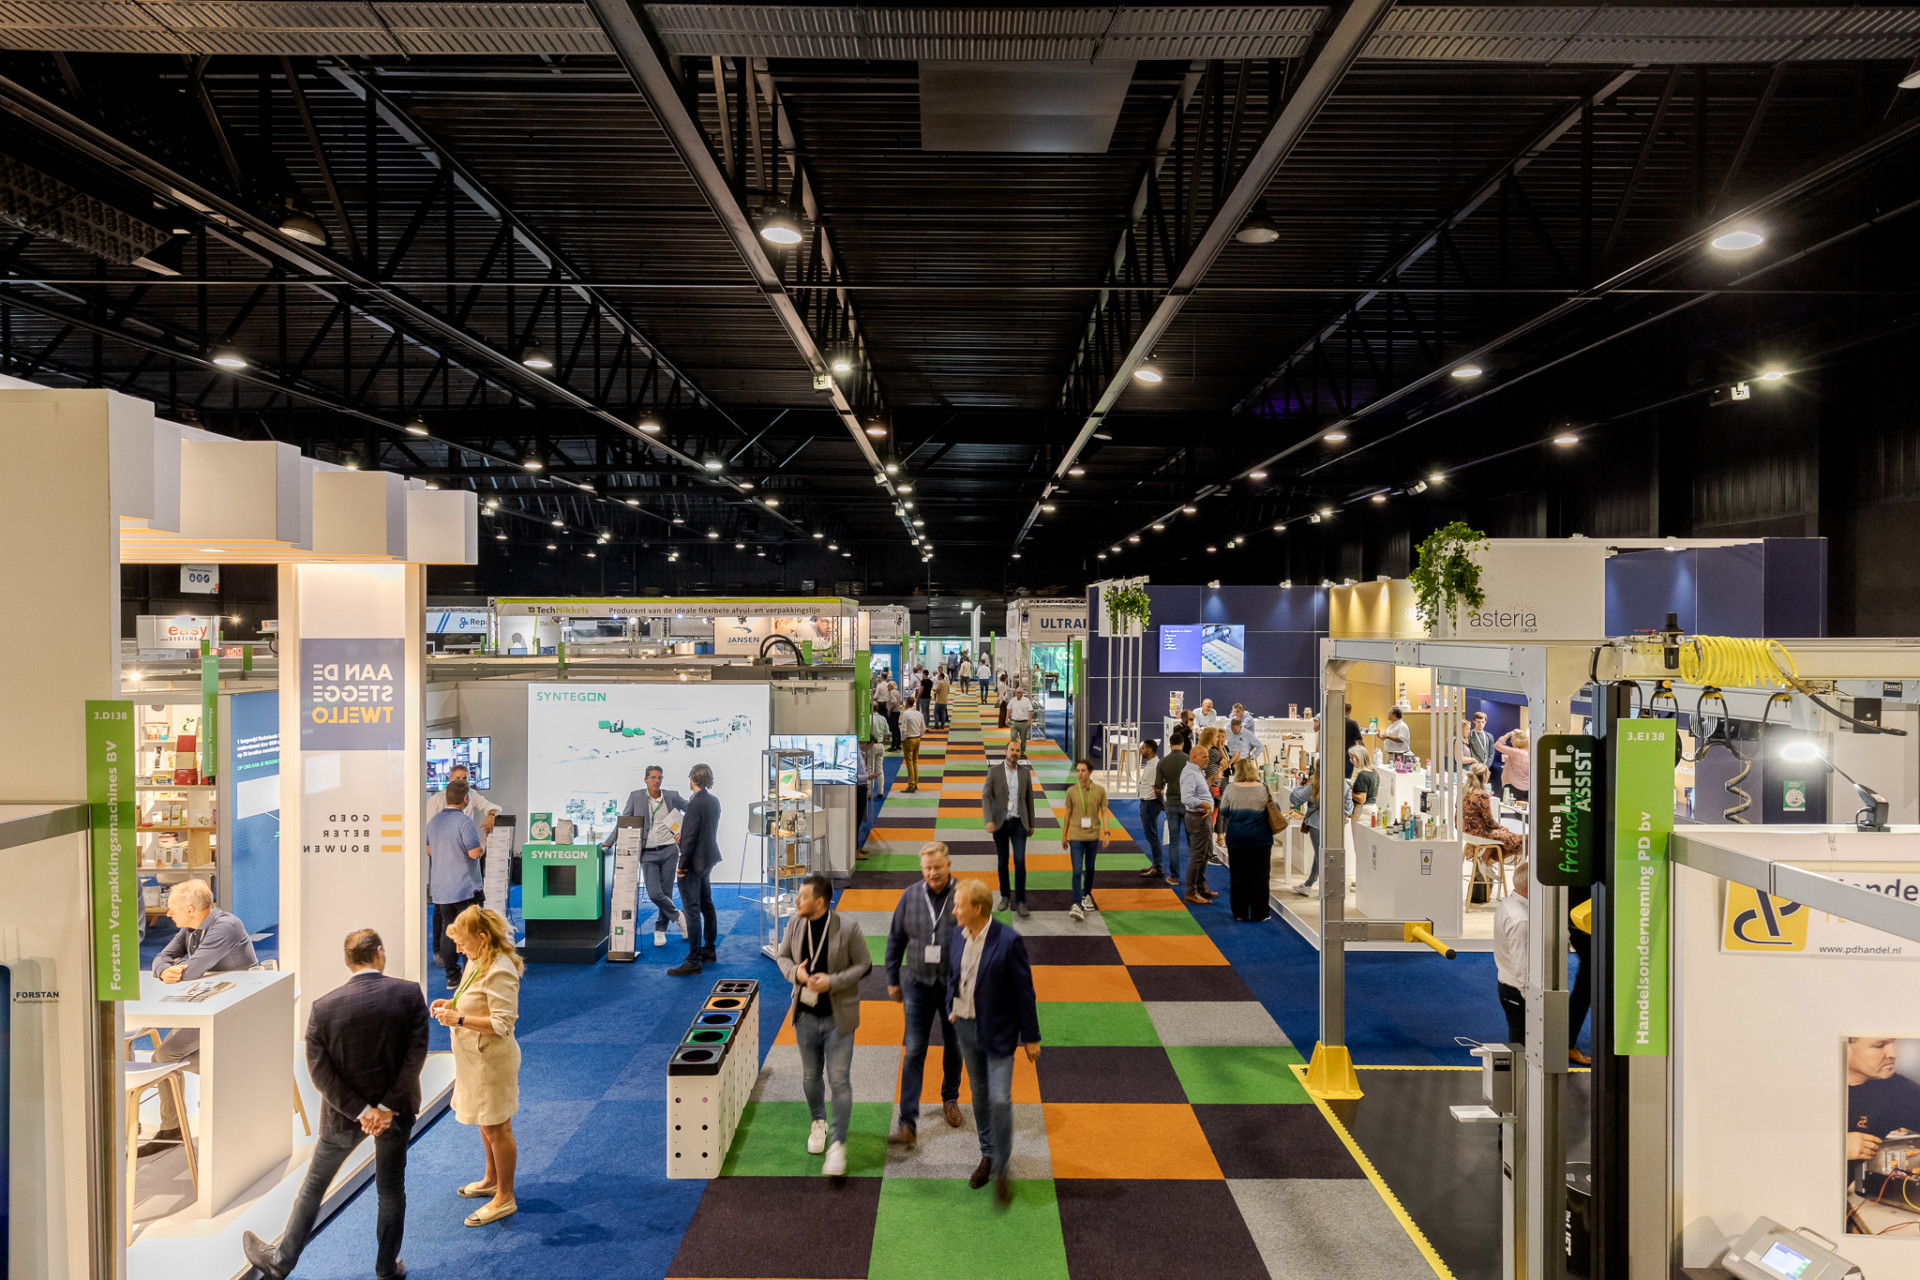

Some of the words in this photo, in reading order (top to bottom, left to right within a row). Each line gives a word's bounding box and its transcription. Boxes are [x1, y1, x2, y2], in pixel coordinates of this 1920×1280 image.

[537, 606, 589, 614] TechNikkels
[765, 607, 821, 616] verpakkingslijn
[1470, 609, 1537, 628] asteria
[168, 625, 208, 641] easy
[536, 691, 607, 702] SYNTEGON
[93, 711, 128, 720] 3.D138
[1626, 732, 1665, 741] 3.E138
[106, 740, 118, 763] BV
[1575, 749, 1592, 813] ASSIST
[1550, 815, 1562, 840] The
[1637, 811, 1651, 832] bv
[1558, 791, 1585, 873] friendly
[106, 767, 122, 931] Verpakkingsmachines
[531, 850, 588, 860] SYNTEGON
[1637, 836, 1650, 861] PD
[1636, 865, 1654, 1044] Handelsonderneming
[1819, 945, 1902, 955] www.pdhandel.nl
[110, 932, 121, 991] Forstan
